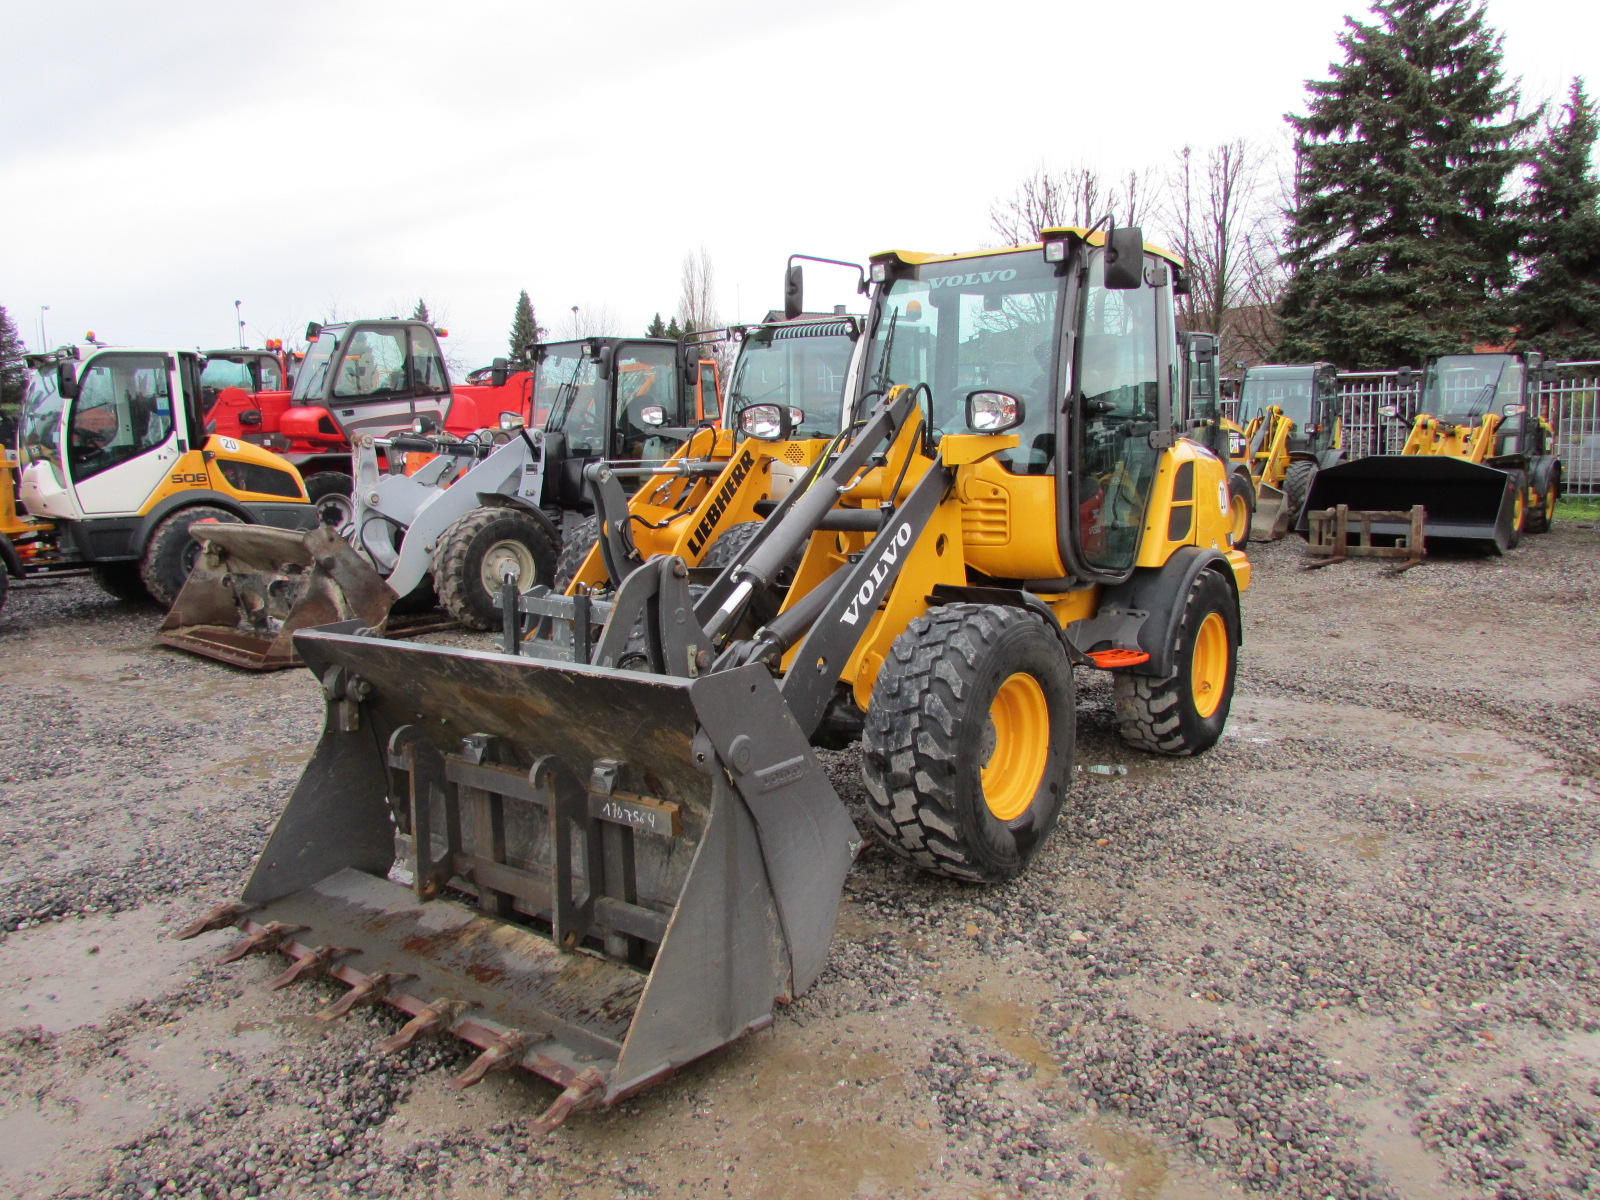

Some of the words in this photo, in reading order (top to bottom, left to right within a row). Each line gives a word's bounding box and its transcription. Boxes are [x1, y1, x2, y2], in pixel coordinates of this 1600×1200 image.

[928, 269, 1017, 290] VOLVO
[223, 438, 236, 450] 20
[1230, 439, 1239, 454] CAT
[171, 473, 207, 484] 506
[687, 450, 755, 558] LIEBHERR
[840, 522, 912, 625] VOLVO
[602, 802, 655, 828] 1707564
